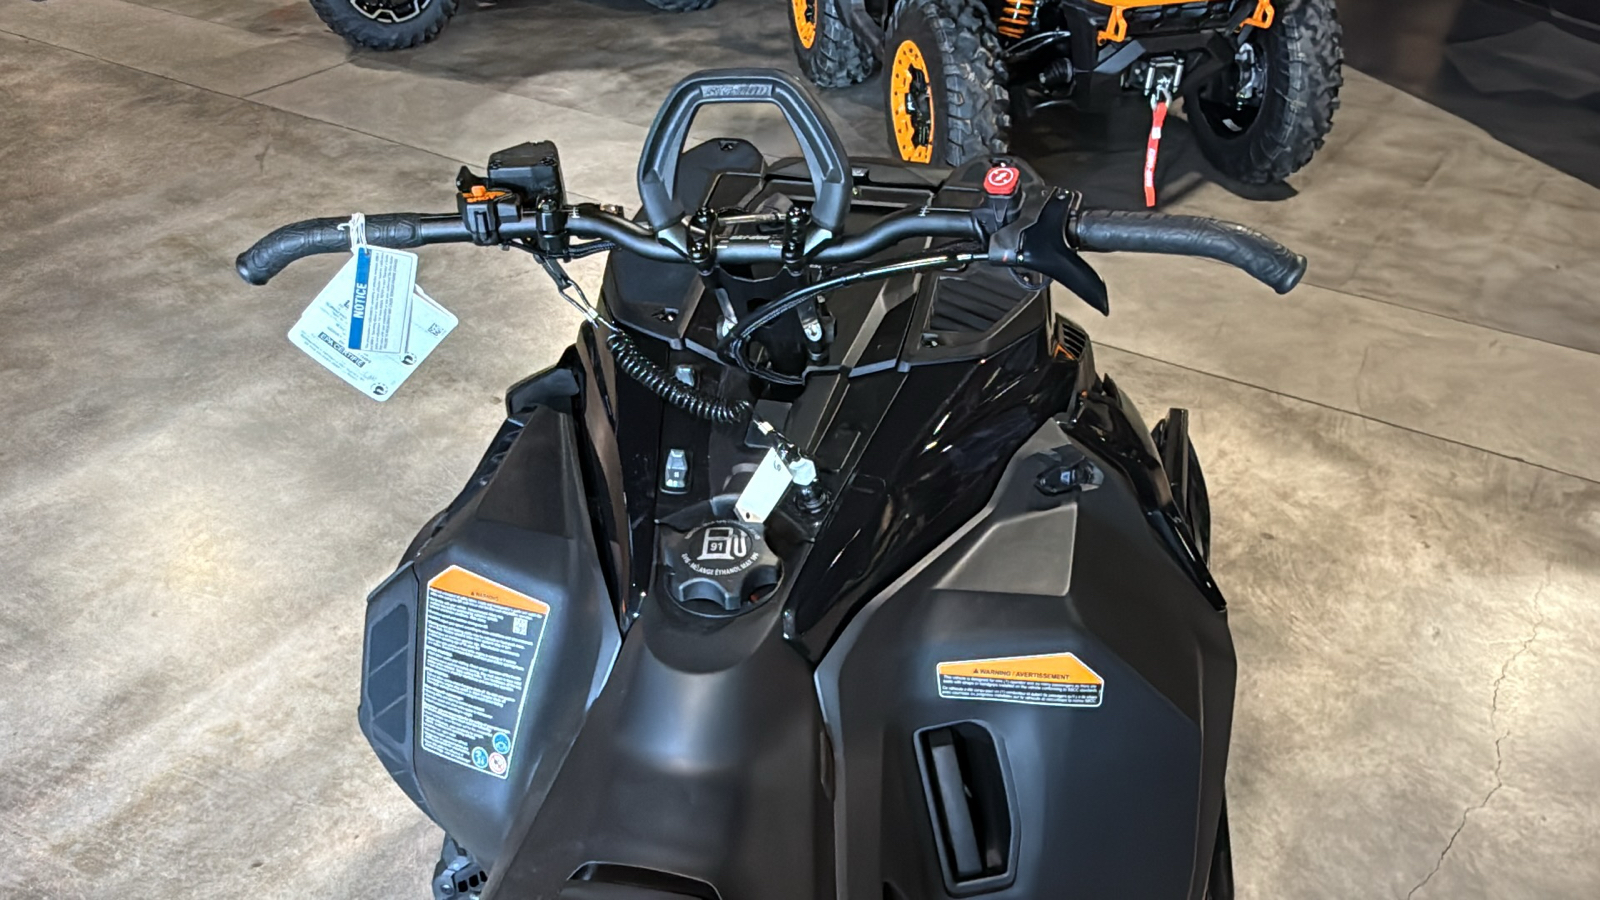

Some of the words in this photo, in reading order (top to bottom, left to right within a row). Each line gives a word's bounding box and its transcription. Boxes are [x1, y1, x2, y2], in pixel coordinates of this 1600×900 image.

[353, 282, 367, 319] NOTICE
[710, 542, 723, 551] 91
[980, 669, 1011, 677] WARNING
[1015, 670, 1070, 680] AVERTISSEMENT
